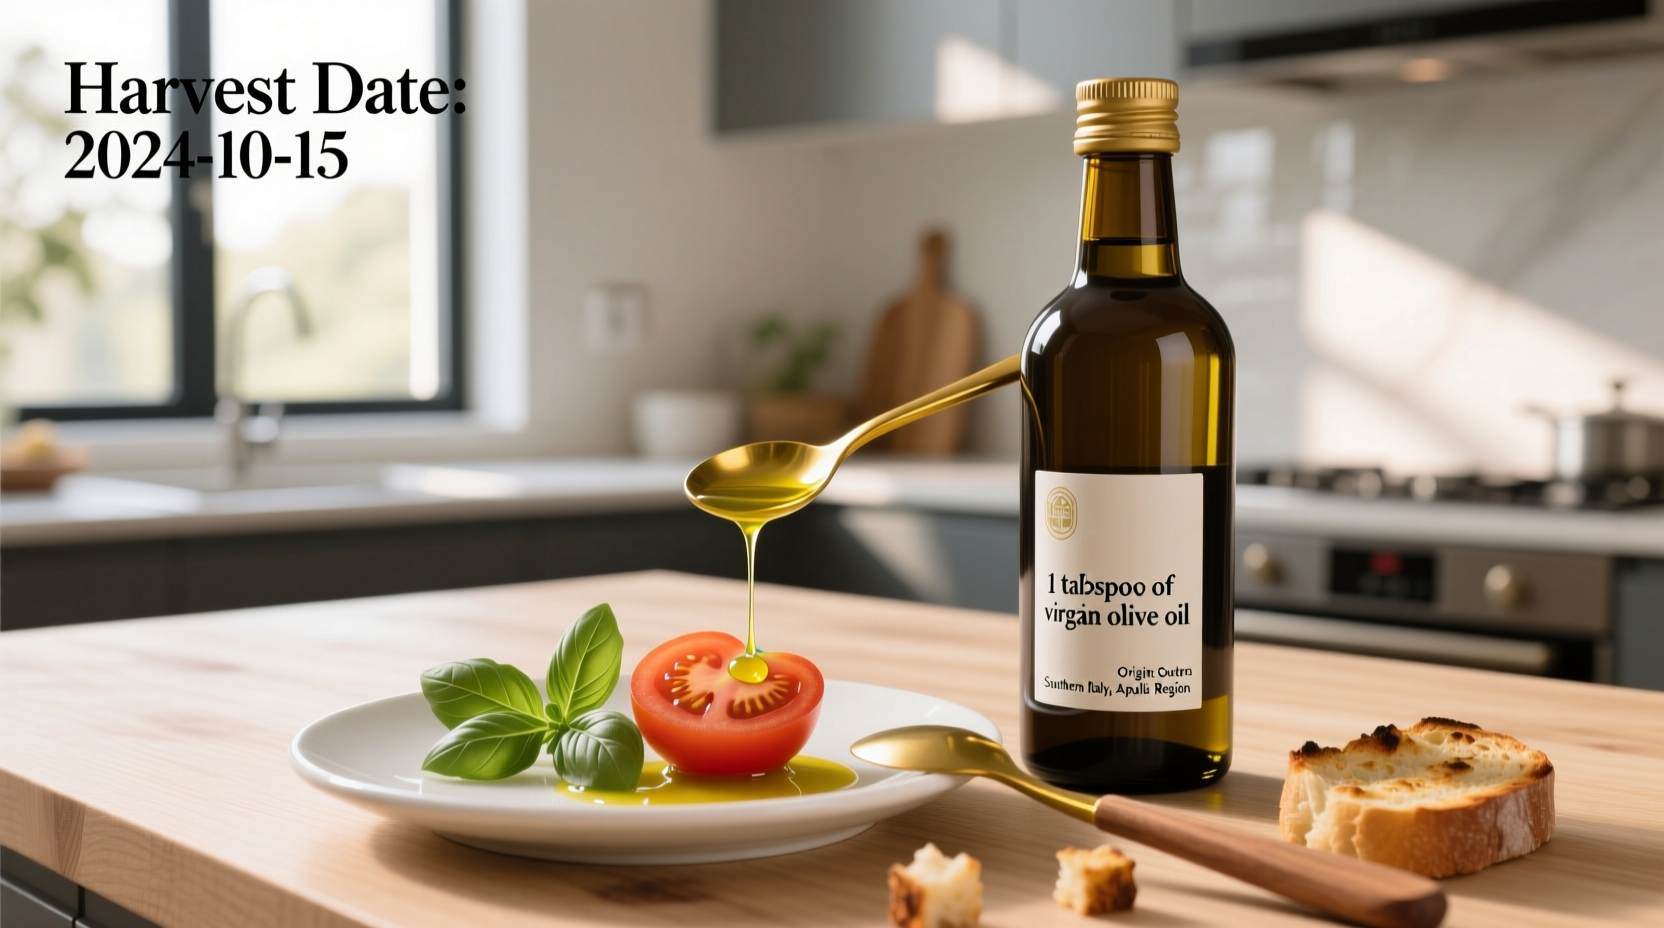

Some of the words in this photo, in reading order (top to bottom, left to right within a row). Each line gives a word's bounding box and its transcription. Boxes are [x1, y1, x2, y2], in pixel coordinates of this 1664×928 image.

[1048, 573, 1055, 594] 1
[1152, 574, 1175, 596] of
[1107, 603, 1159, 626] olive
[1165, 603, 1190, 626] oil
